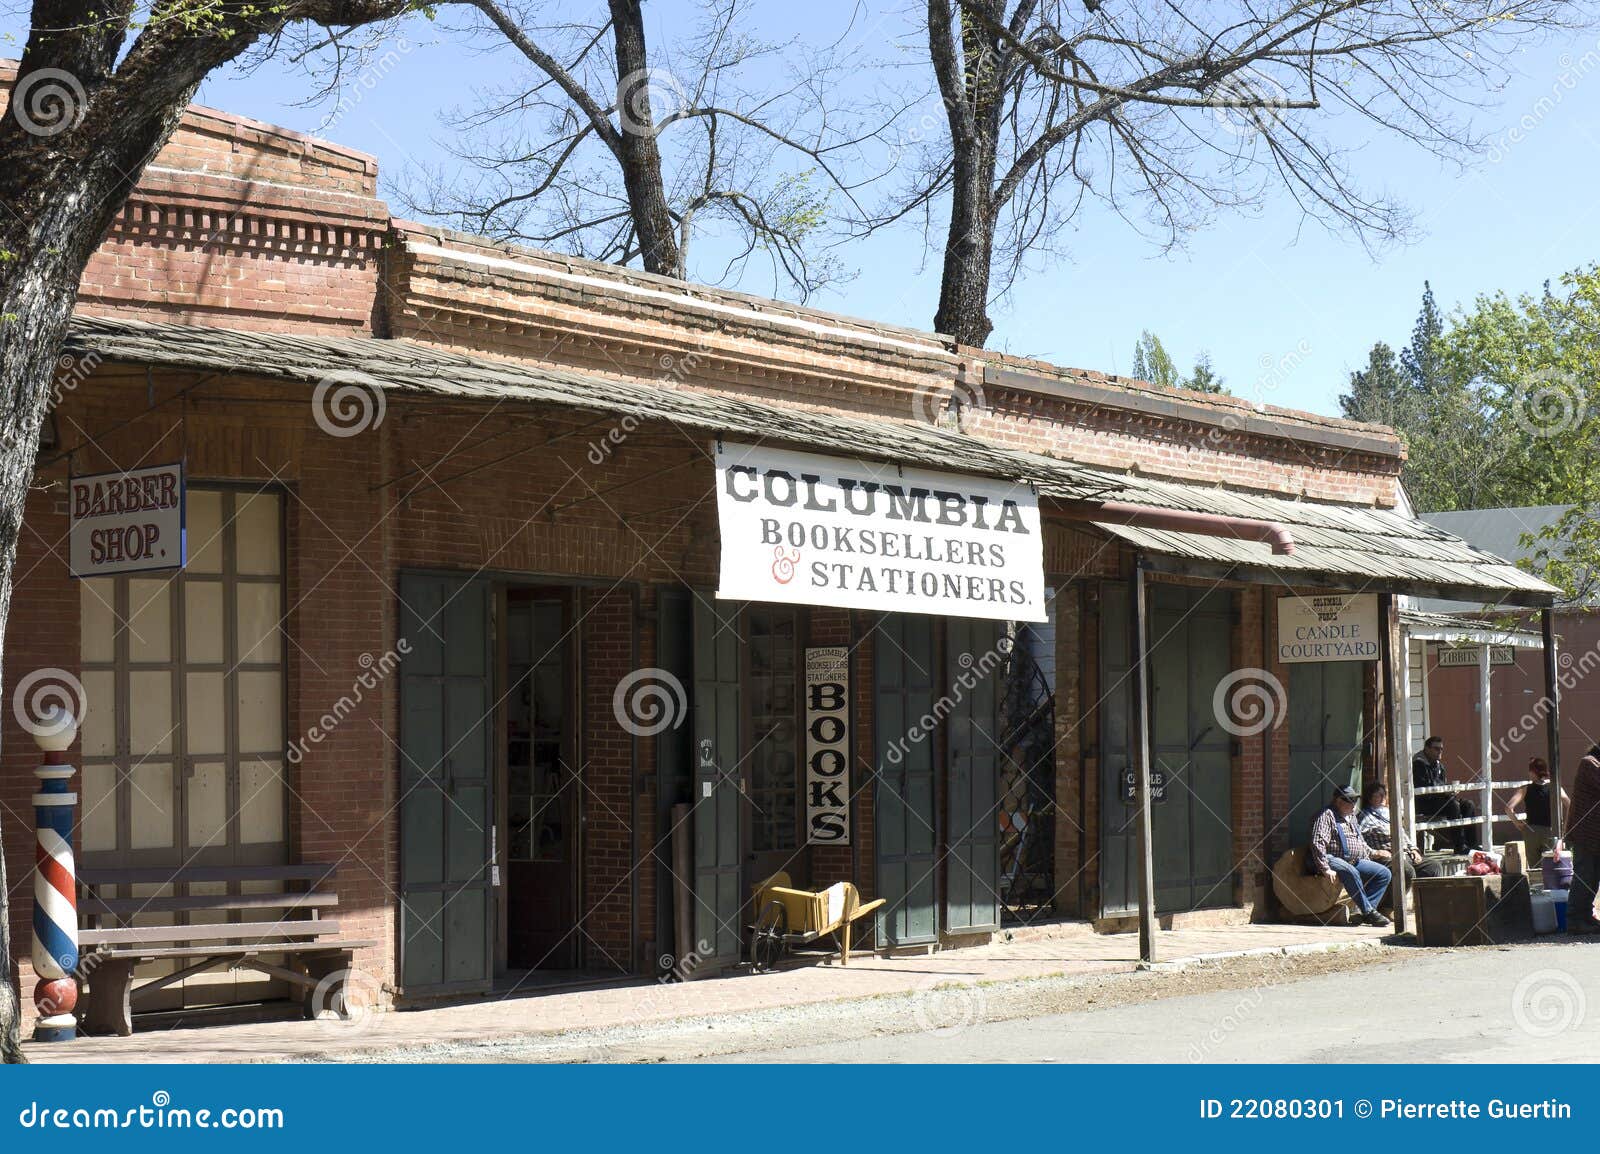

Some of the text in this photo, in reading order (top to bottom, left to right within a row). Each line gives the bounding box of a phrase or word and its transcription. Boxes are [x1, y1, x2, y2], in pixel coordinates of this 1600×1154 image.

[73, 472, 179, 519] BARBER
[726, 464, 1030, 535] COLUMBIA
[90, 523, 166, 565] SHOP.
[760, 518, 1006, 568] BOOKSELLERS
[771, 545, 1032, 606] & STATIONERS.
[1280, 641, 1377, 658] COURTYARD
[1295, 624, 1360, 640] CANDLE
